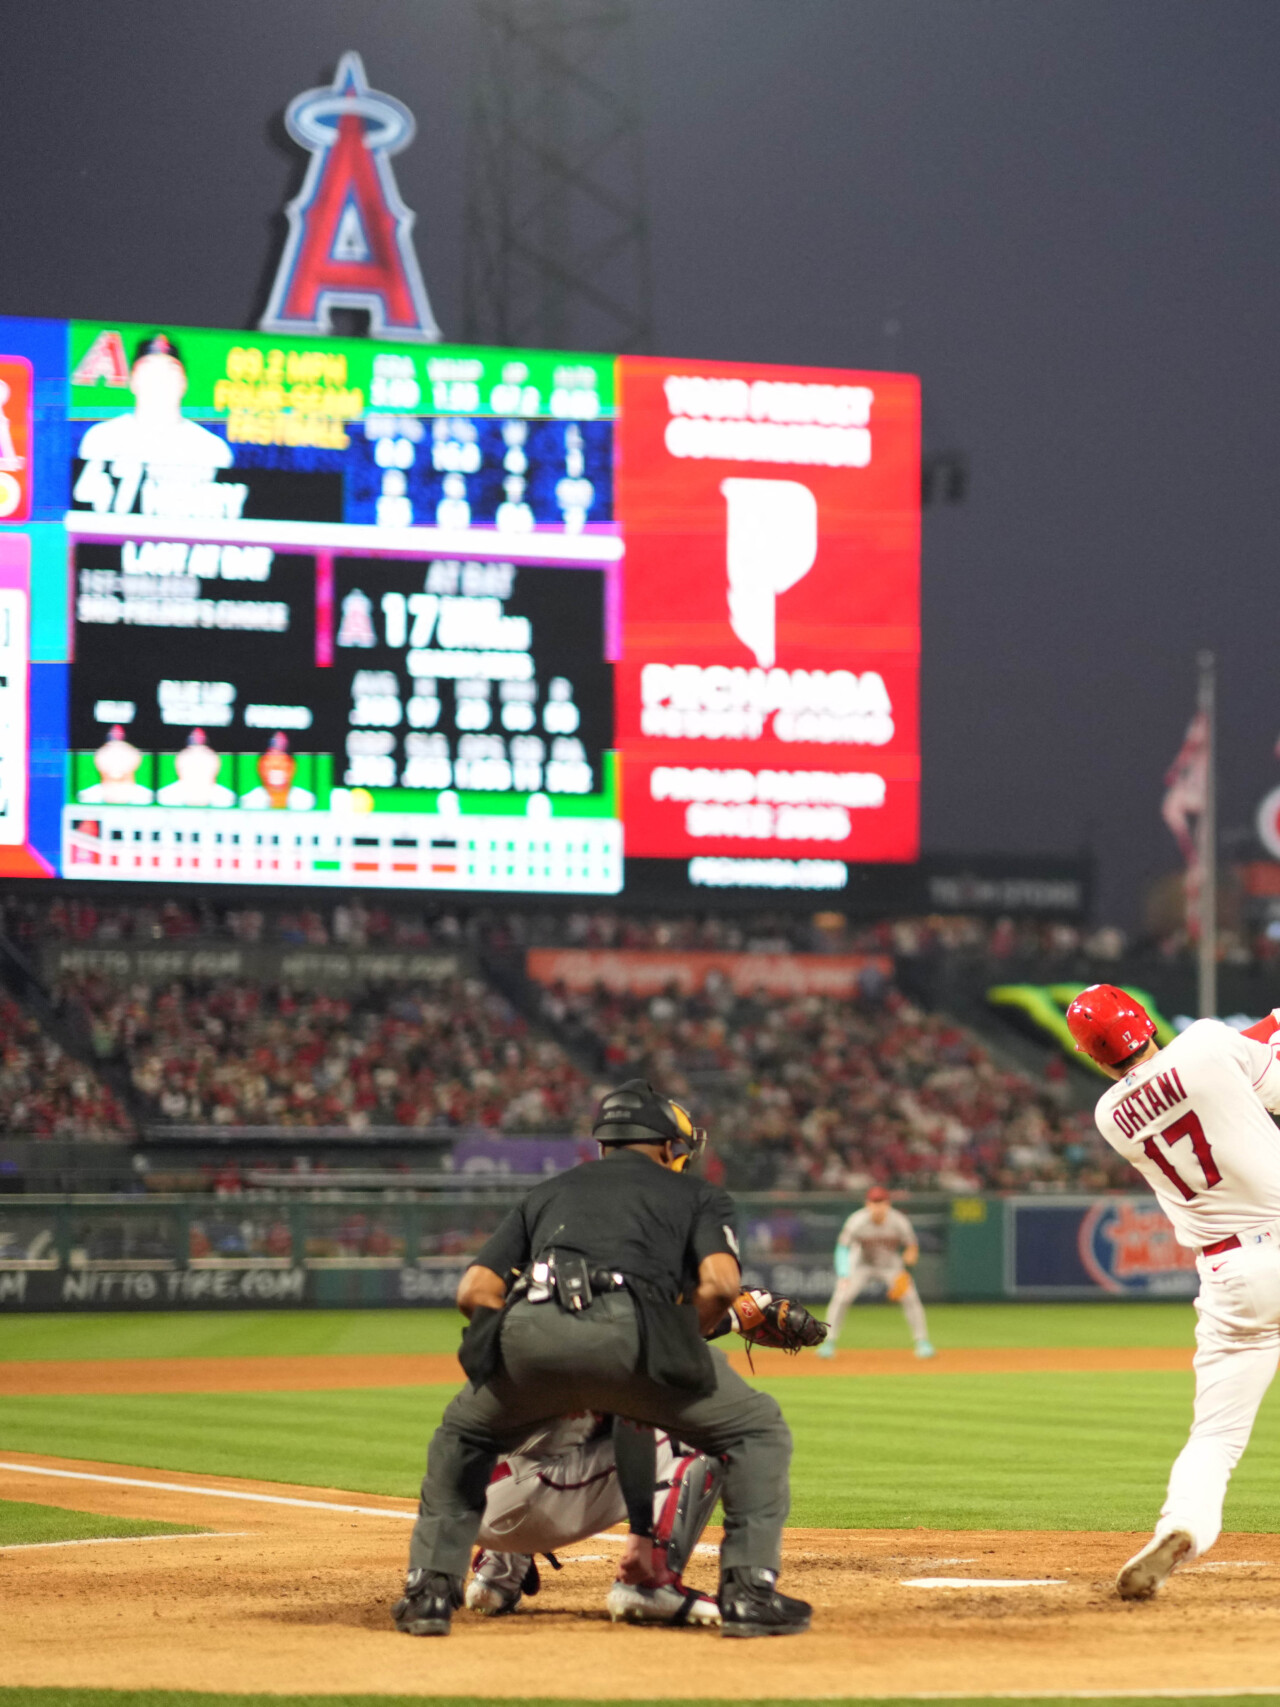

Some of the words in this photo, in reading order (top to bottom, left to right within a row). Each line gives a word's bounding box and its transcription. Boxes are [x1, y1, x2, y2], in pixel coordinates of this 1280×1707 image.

[260, 51, 444, 343] A
[381, 592, 439, 648] 17
[1122, 1031, 1132, 1042] 17
[1113, 1067, 1188, 1140] OHTANI
[1143, 1109, 1223, 1201] 17
[62, 1270, 157, 1300] NITTO
